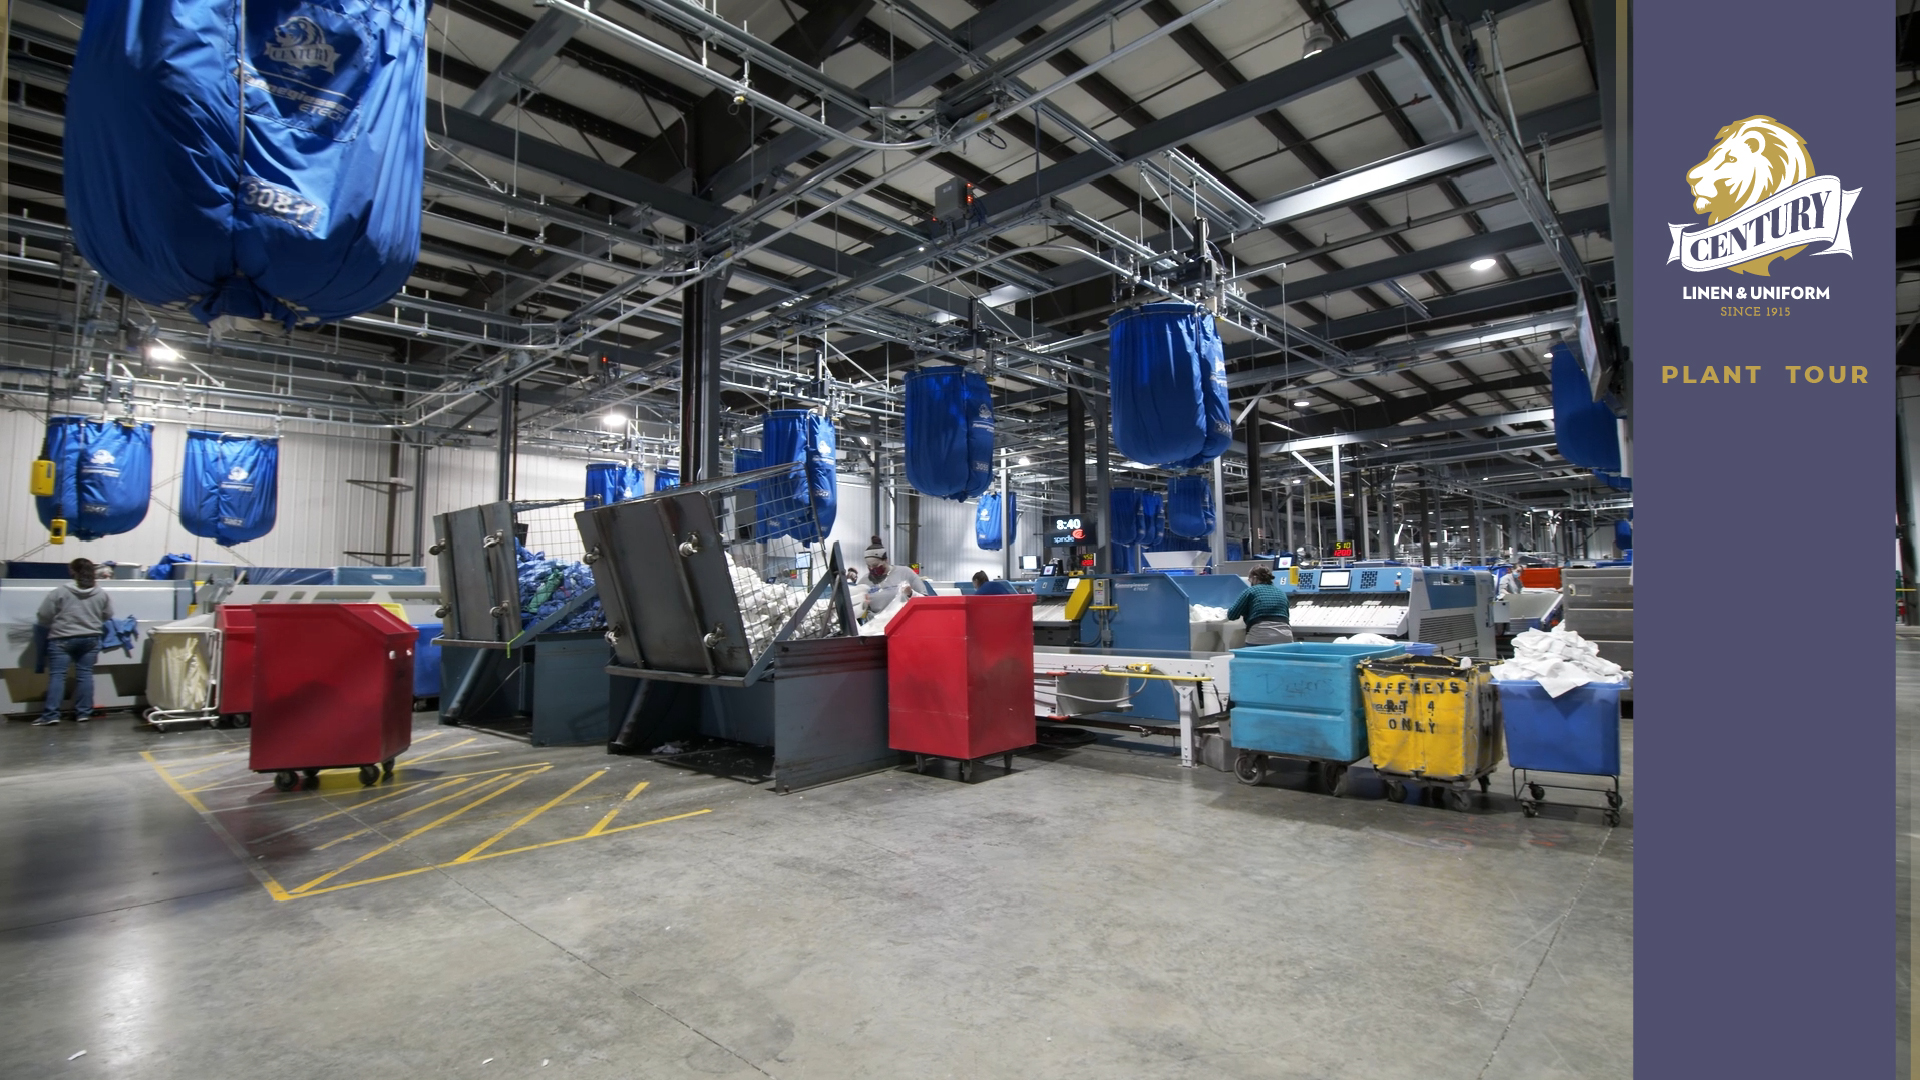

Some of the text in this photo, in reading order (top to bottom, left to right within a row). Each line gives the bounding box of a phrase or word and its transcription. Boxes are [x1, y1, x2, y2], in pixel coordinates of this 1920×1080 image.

[271, 47, 329, 63] CENTURY
[298, 102, 346, 122] ETECH
[1056, 518, 1081, 530] 8:40
[1388, 717, 1436, 735] ONLY
